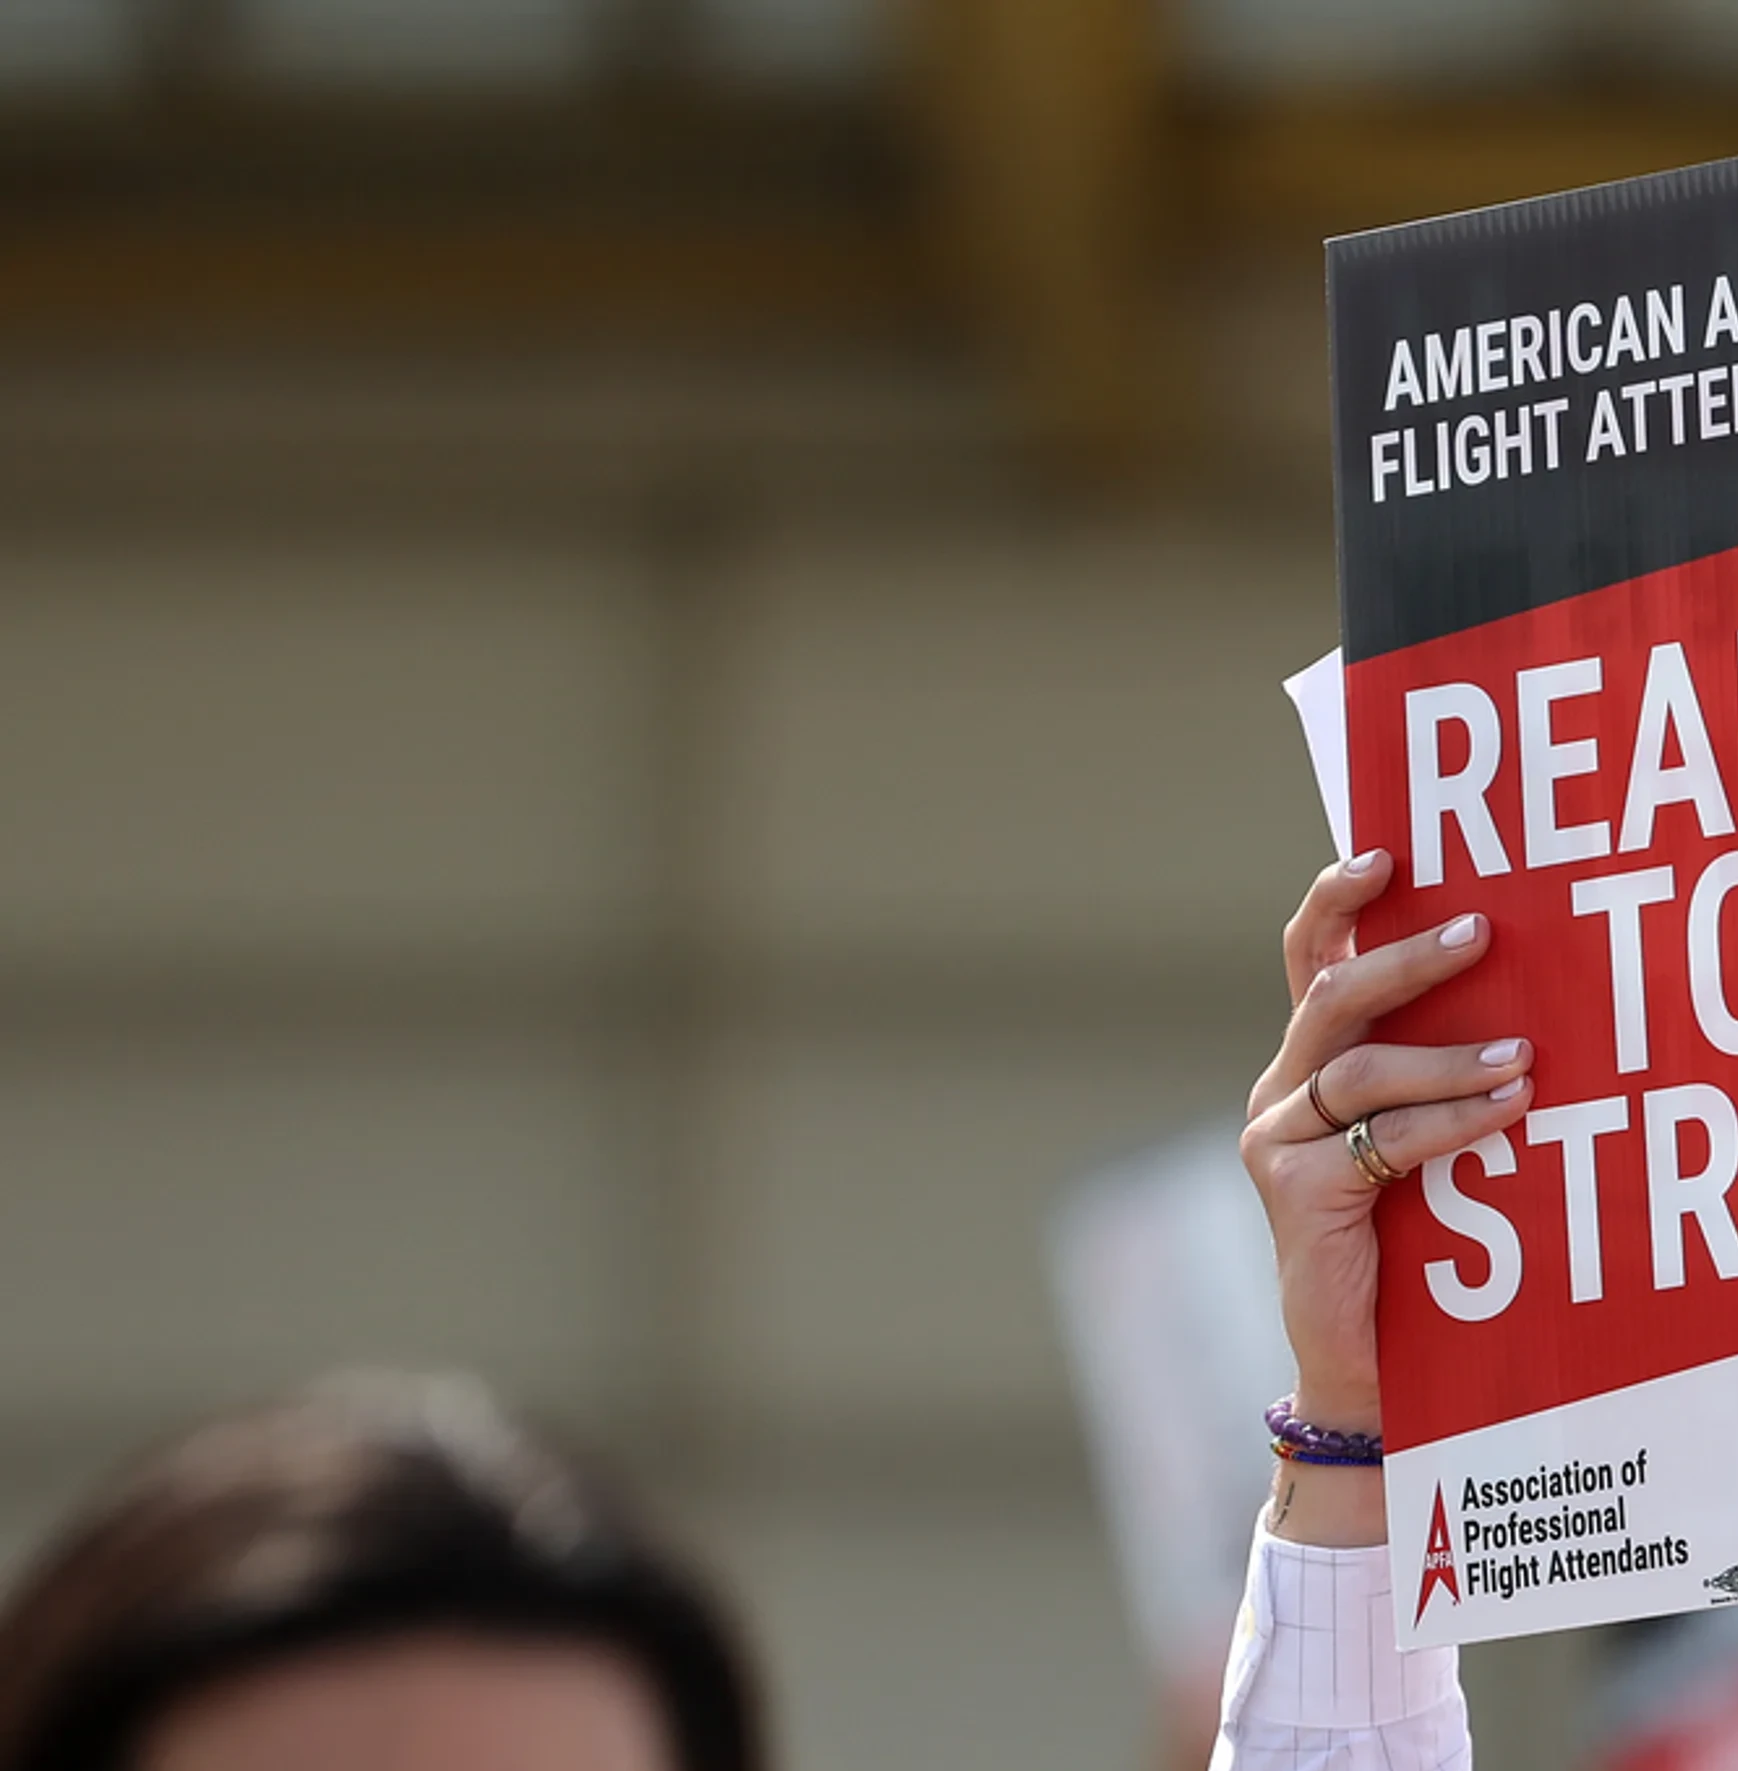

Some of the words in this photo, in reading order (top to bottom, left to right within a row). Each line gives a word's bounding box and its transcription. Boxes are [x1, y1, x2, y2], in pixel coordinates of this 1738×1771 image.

[1383, 284, 1685, 411] AMERICAN
[1370, 399, 1569, 503] FLIGHT
[1461, 1459, 1613, 1511] Association
[1621, 1448, 1648, 1487] of
[1463, 1496, 1626, 1553] Professional
[1466, 1552, 1541, 1600] Flight
[1548, 1535, 1689, 1585] Attendants
